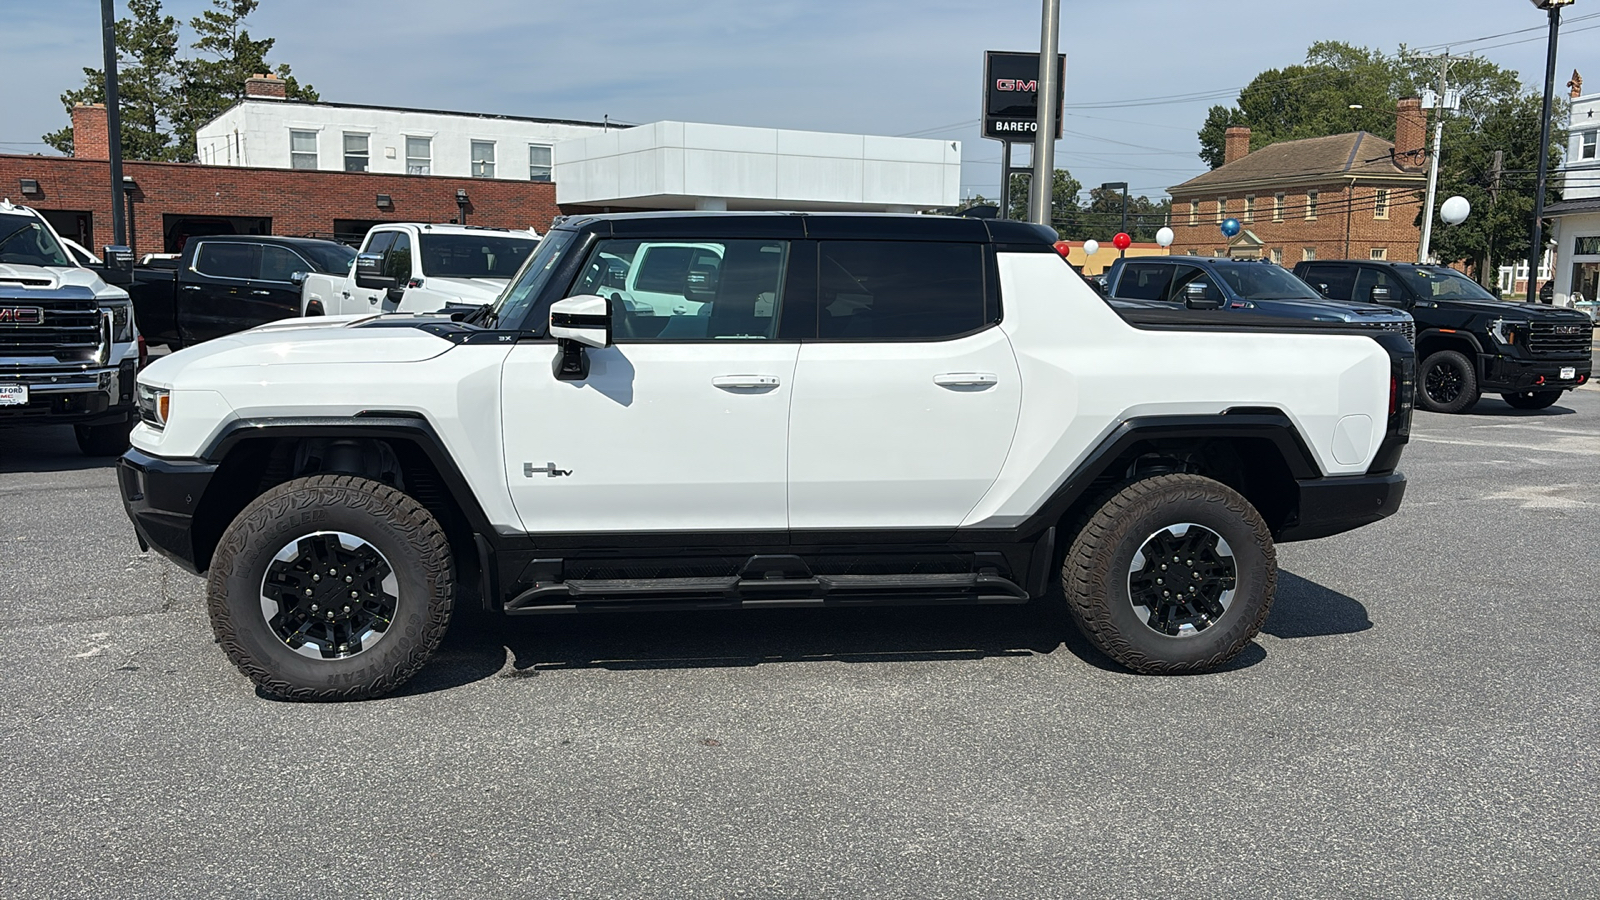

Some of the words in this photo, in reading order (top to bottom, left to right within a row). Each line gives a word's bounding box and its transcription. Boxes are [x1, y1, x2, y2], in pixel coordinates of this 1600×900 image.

[997, 79, 1039, 91] GM
[996, 122, 1038, 132] BAREFO
[0, 309, 37, 321] MC
[236, 509, 327, 579] WRANGLER
